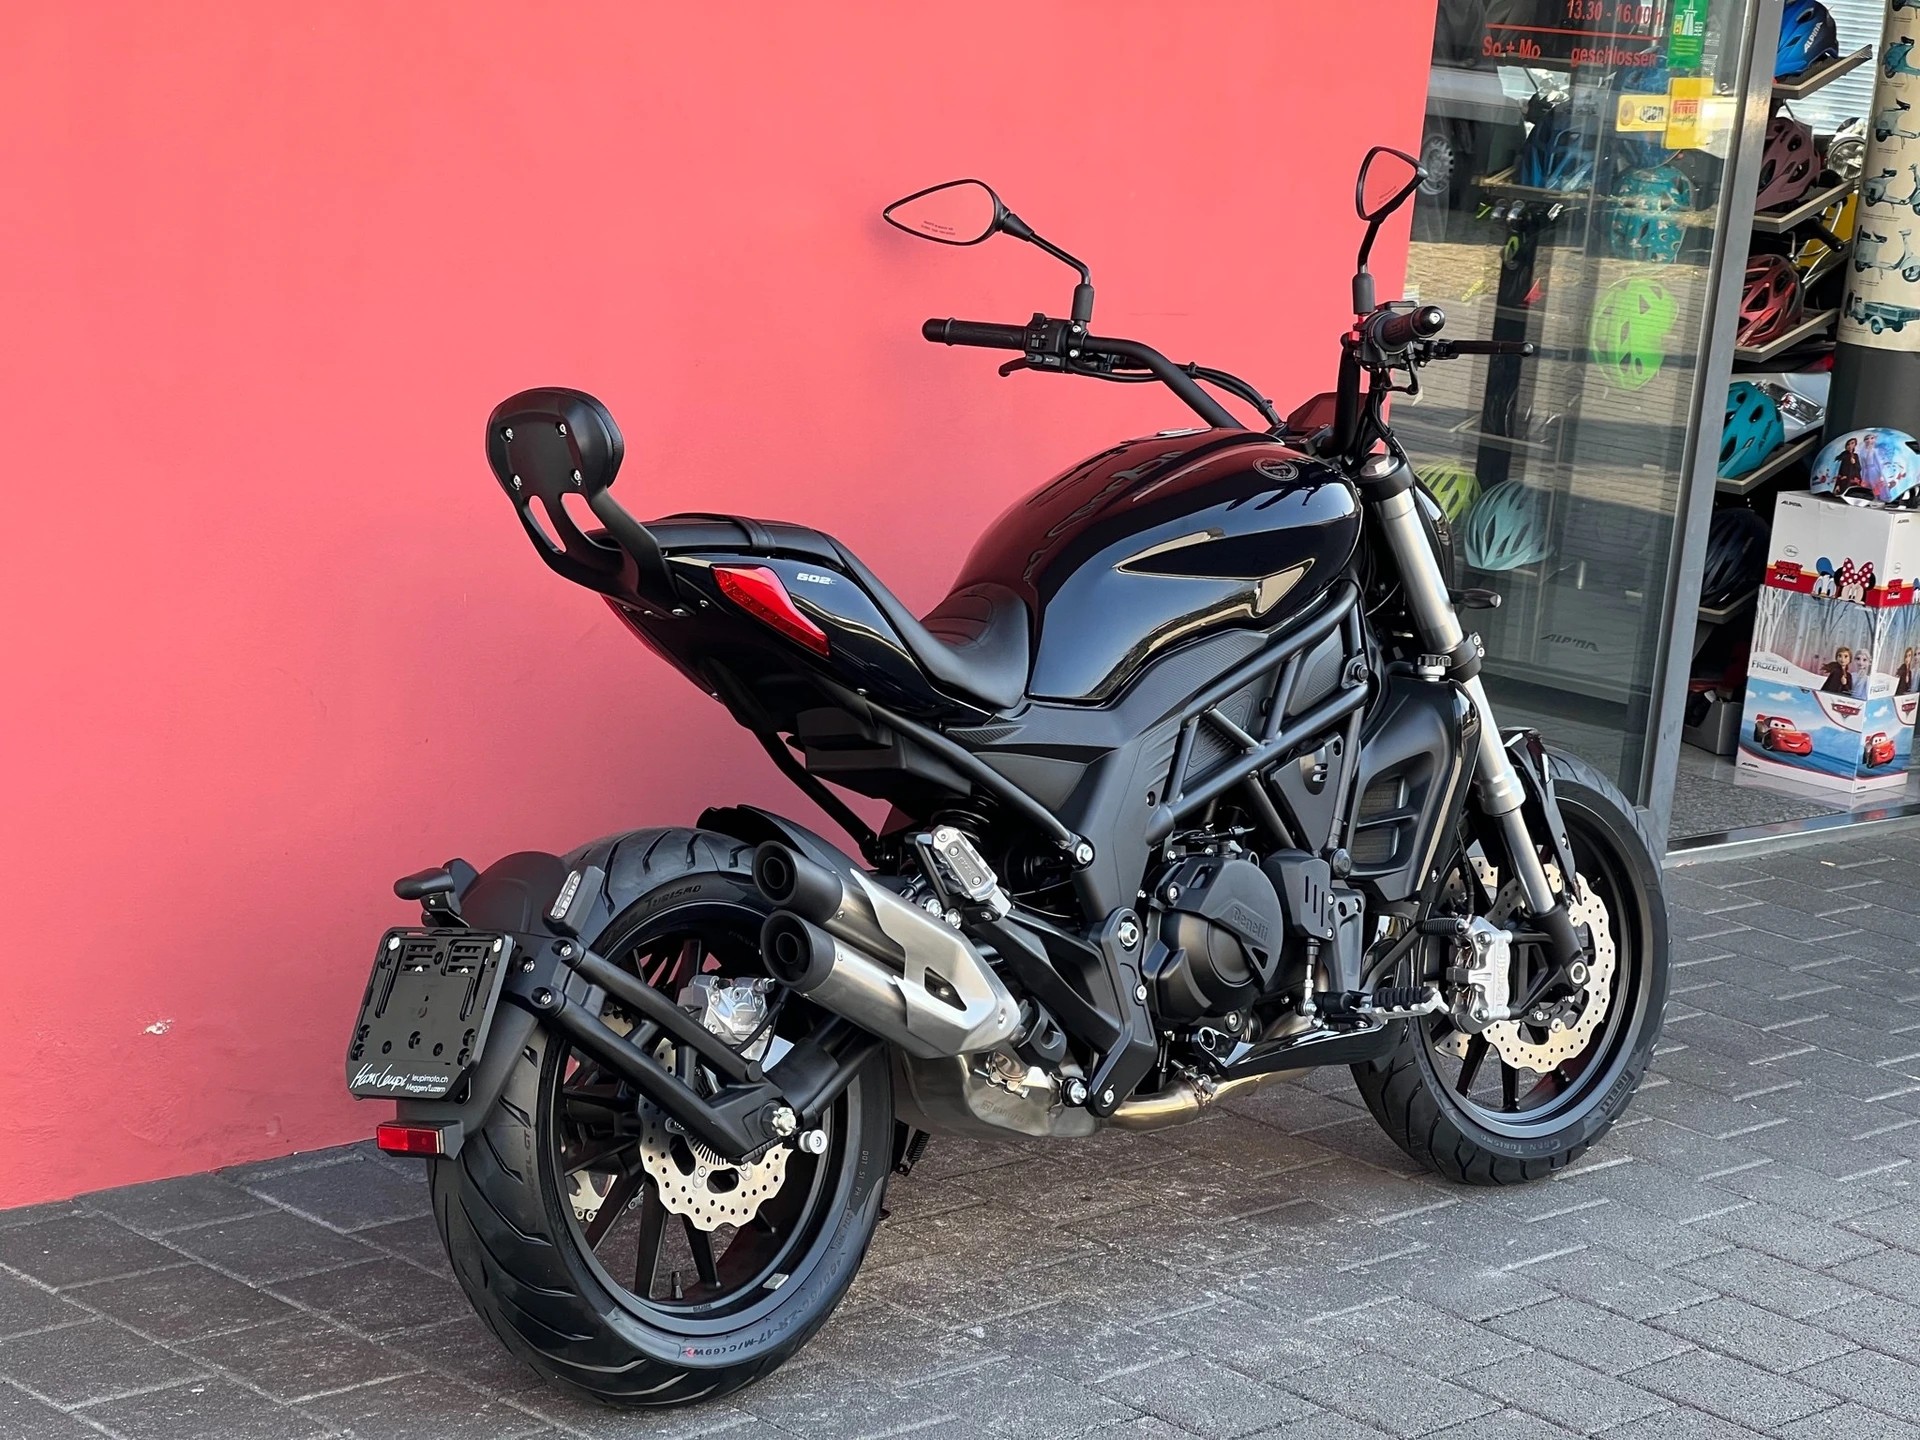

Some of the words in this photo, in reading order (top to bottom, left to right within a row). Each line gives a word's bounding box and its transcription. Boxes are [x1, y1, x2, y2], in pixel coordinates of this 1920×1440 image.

[1567, 0, 1603, 21] 13.30
[1482, 35, 1502, 57] So
[1519, 38, 1541, 60] Mo
[1570, 46, 1658, 68] geschlossen
[1804, 21, 1823, 53] ALPINA
[1232, 905, 1269, 942] Benelli
[411, 1073, 449, 1083] leupimoto.ch
